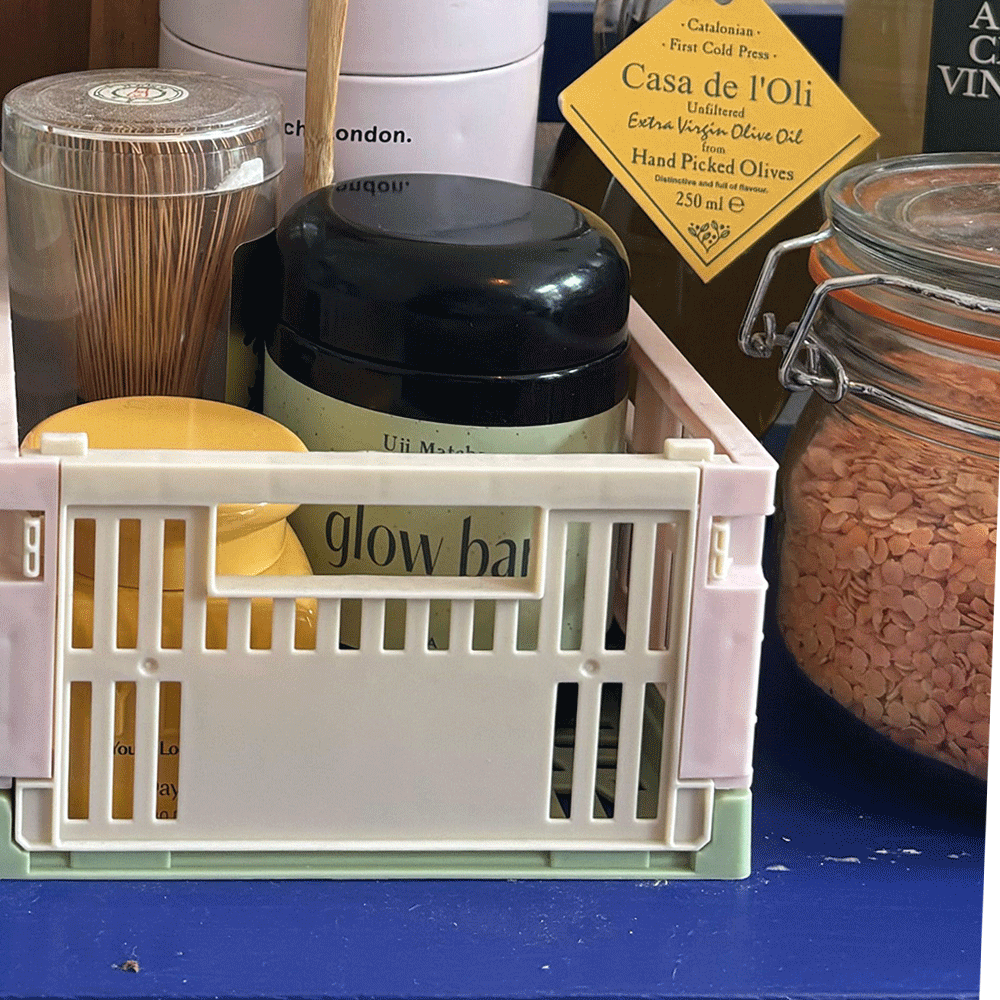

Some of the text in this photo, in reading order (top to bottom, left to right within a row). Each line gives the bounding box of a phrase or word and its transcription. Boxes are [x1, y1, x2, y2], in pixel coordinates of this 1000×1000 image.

[687, 17, 753, 37] Catalonian
[669, 38, 770, 60] First Cold Press
[621, 62, 813, 107] Casa de l'Oli
[687, 100, 745, 118] Unfiltered
[335, 126, 412, 143] ondon.
[627, 111, 804, 145] Extra Virgin Olive Oil
[701, 141, 726, 154] from
[631, 147, 794, 181] Hand Picked Olives
[654, 174, 697, 186] Distinctive
[698, 180, 714, 188] and
[675, 191, 702, 208] 250
[705, 196, 724, 211] ml
[325, 504, 444, 576] glow
